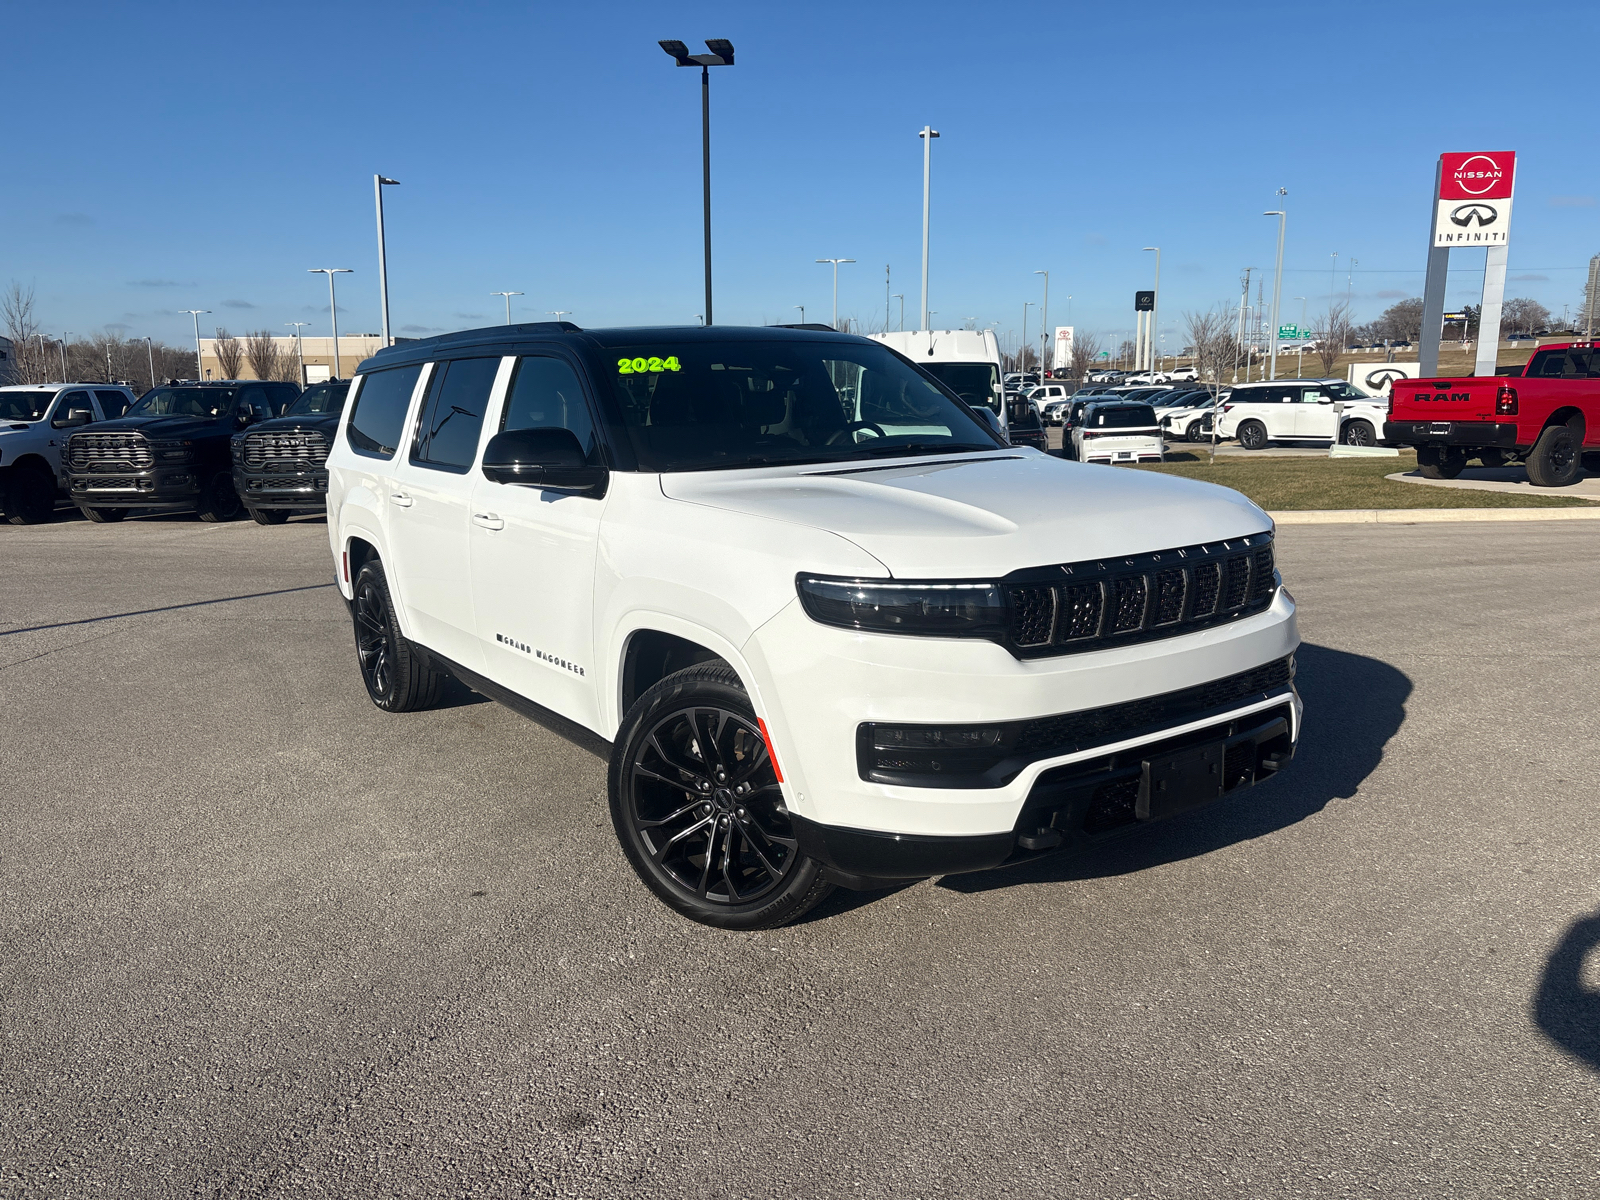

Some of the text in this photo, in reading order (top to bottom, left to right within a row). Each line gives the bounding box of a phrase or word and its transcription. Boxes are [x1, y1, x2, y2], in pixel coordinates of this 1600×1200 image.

[1438, 232, 1505, 242] INFINITI
[617, 356, 682, 375] 2024
[1414, 392, 1471, 402] RAM
[504, 637, 585, 677] GRAND WAGONEER
